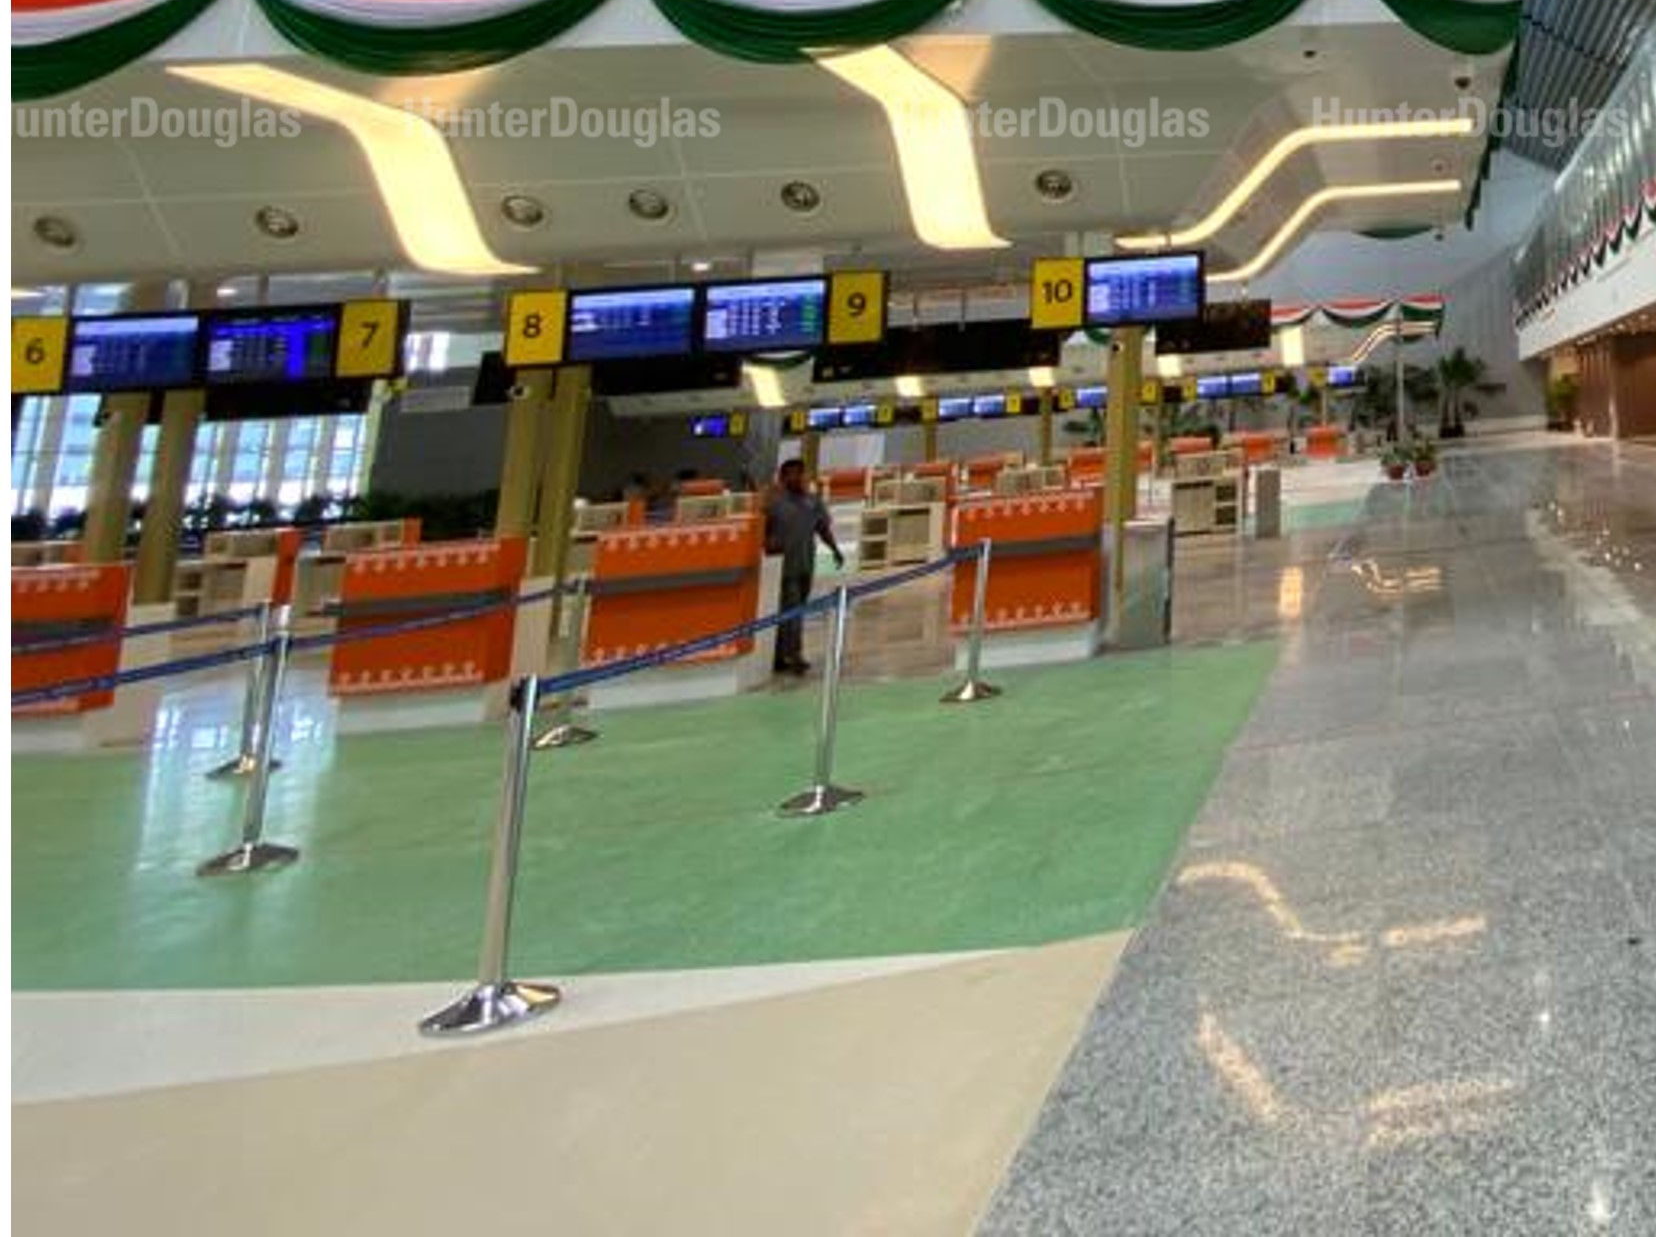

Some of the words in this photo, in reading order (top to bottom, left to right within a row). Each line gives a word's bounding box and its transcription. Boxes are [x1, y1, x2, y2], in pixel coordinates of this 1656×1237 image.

[847, 292, 867, 317] 9
[1042, 279, 1073, 305] 10
[360, 320, 380, 349] 7
[522, 313, 542, 339] 8
[25, 337, 45, 364] 6
